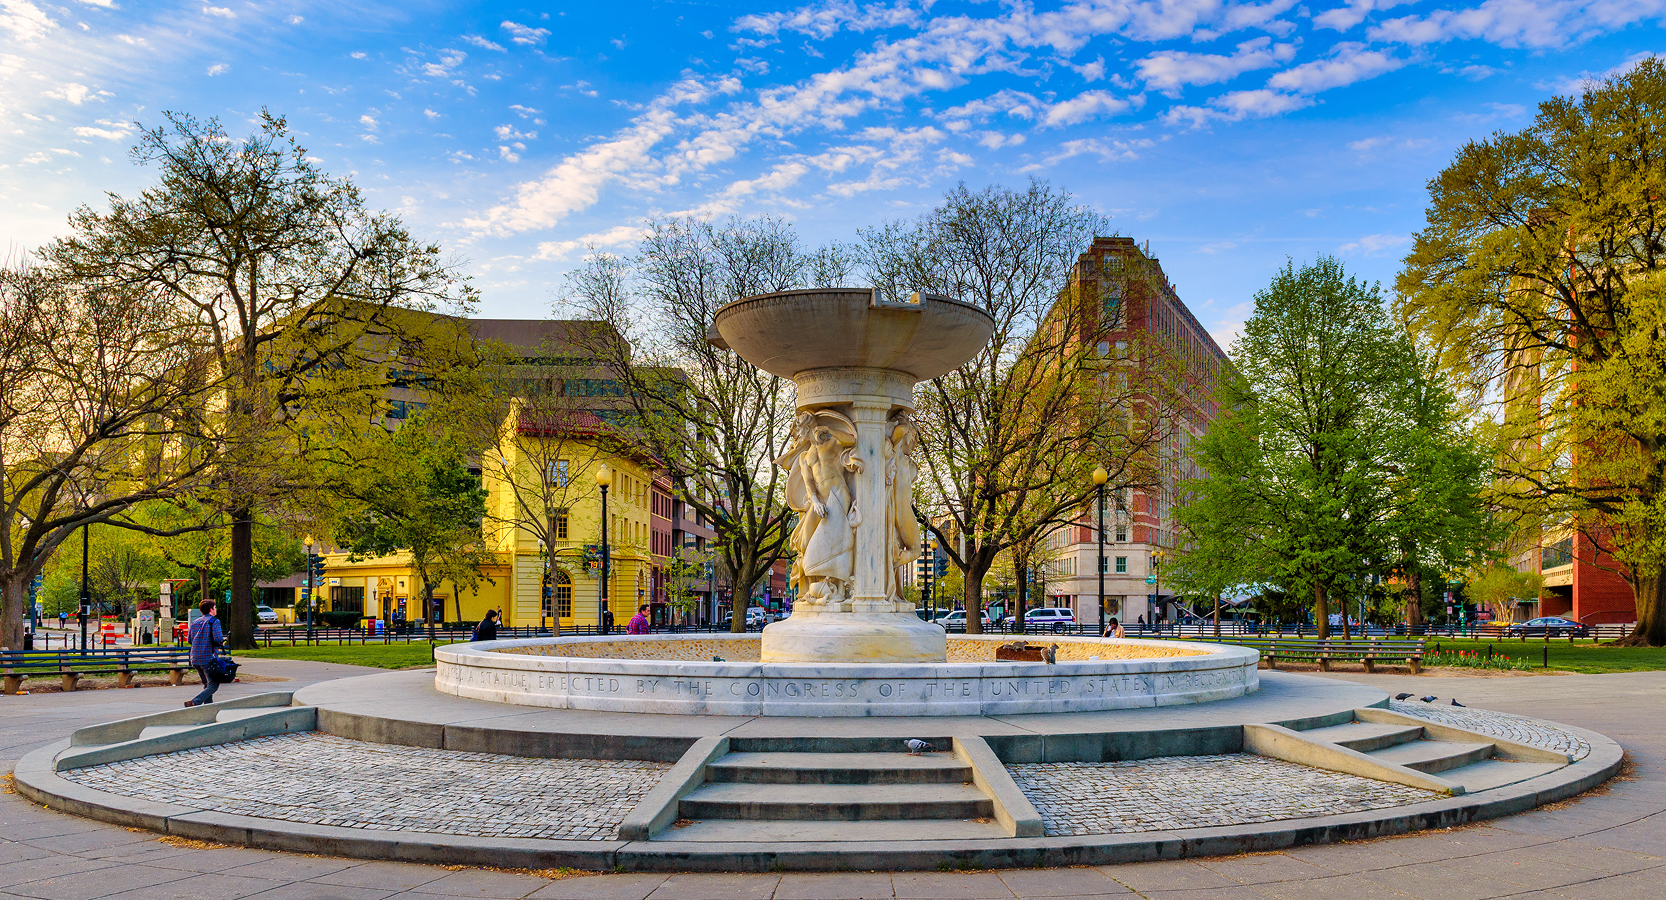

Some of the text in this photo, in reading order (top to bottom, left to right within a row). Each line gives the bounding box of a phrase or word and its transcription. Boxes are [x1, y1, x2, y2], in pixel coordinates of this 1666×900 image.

[468, 670, 474, 682] A
[480, 671, 526, 687] STATUE
[538, 675, 620, 693] ERECTED
[636, 679, 659, 694] BY
[673, 680, 713, 696] THE
[729, 681, 858, 698] CONGRESS
[878, 683, 906, 698] OF
[926, 682, 971, 697] THE
[991, 680, 1071, 696] UNITED
[1087, 677, 1149, 693] STATES
[1161, 675, 1175, 691] IN
